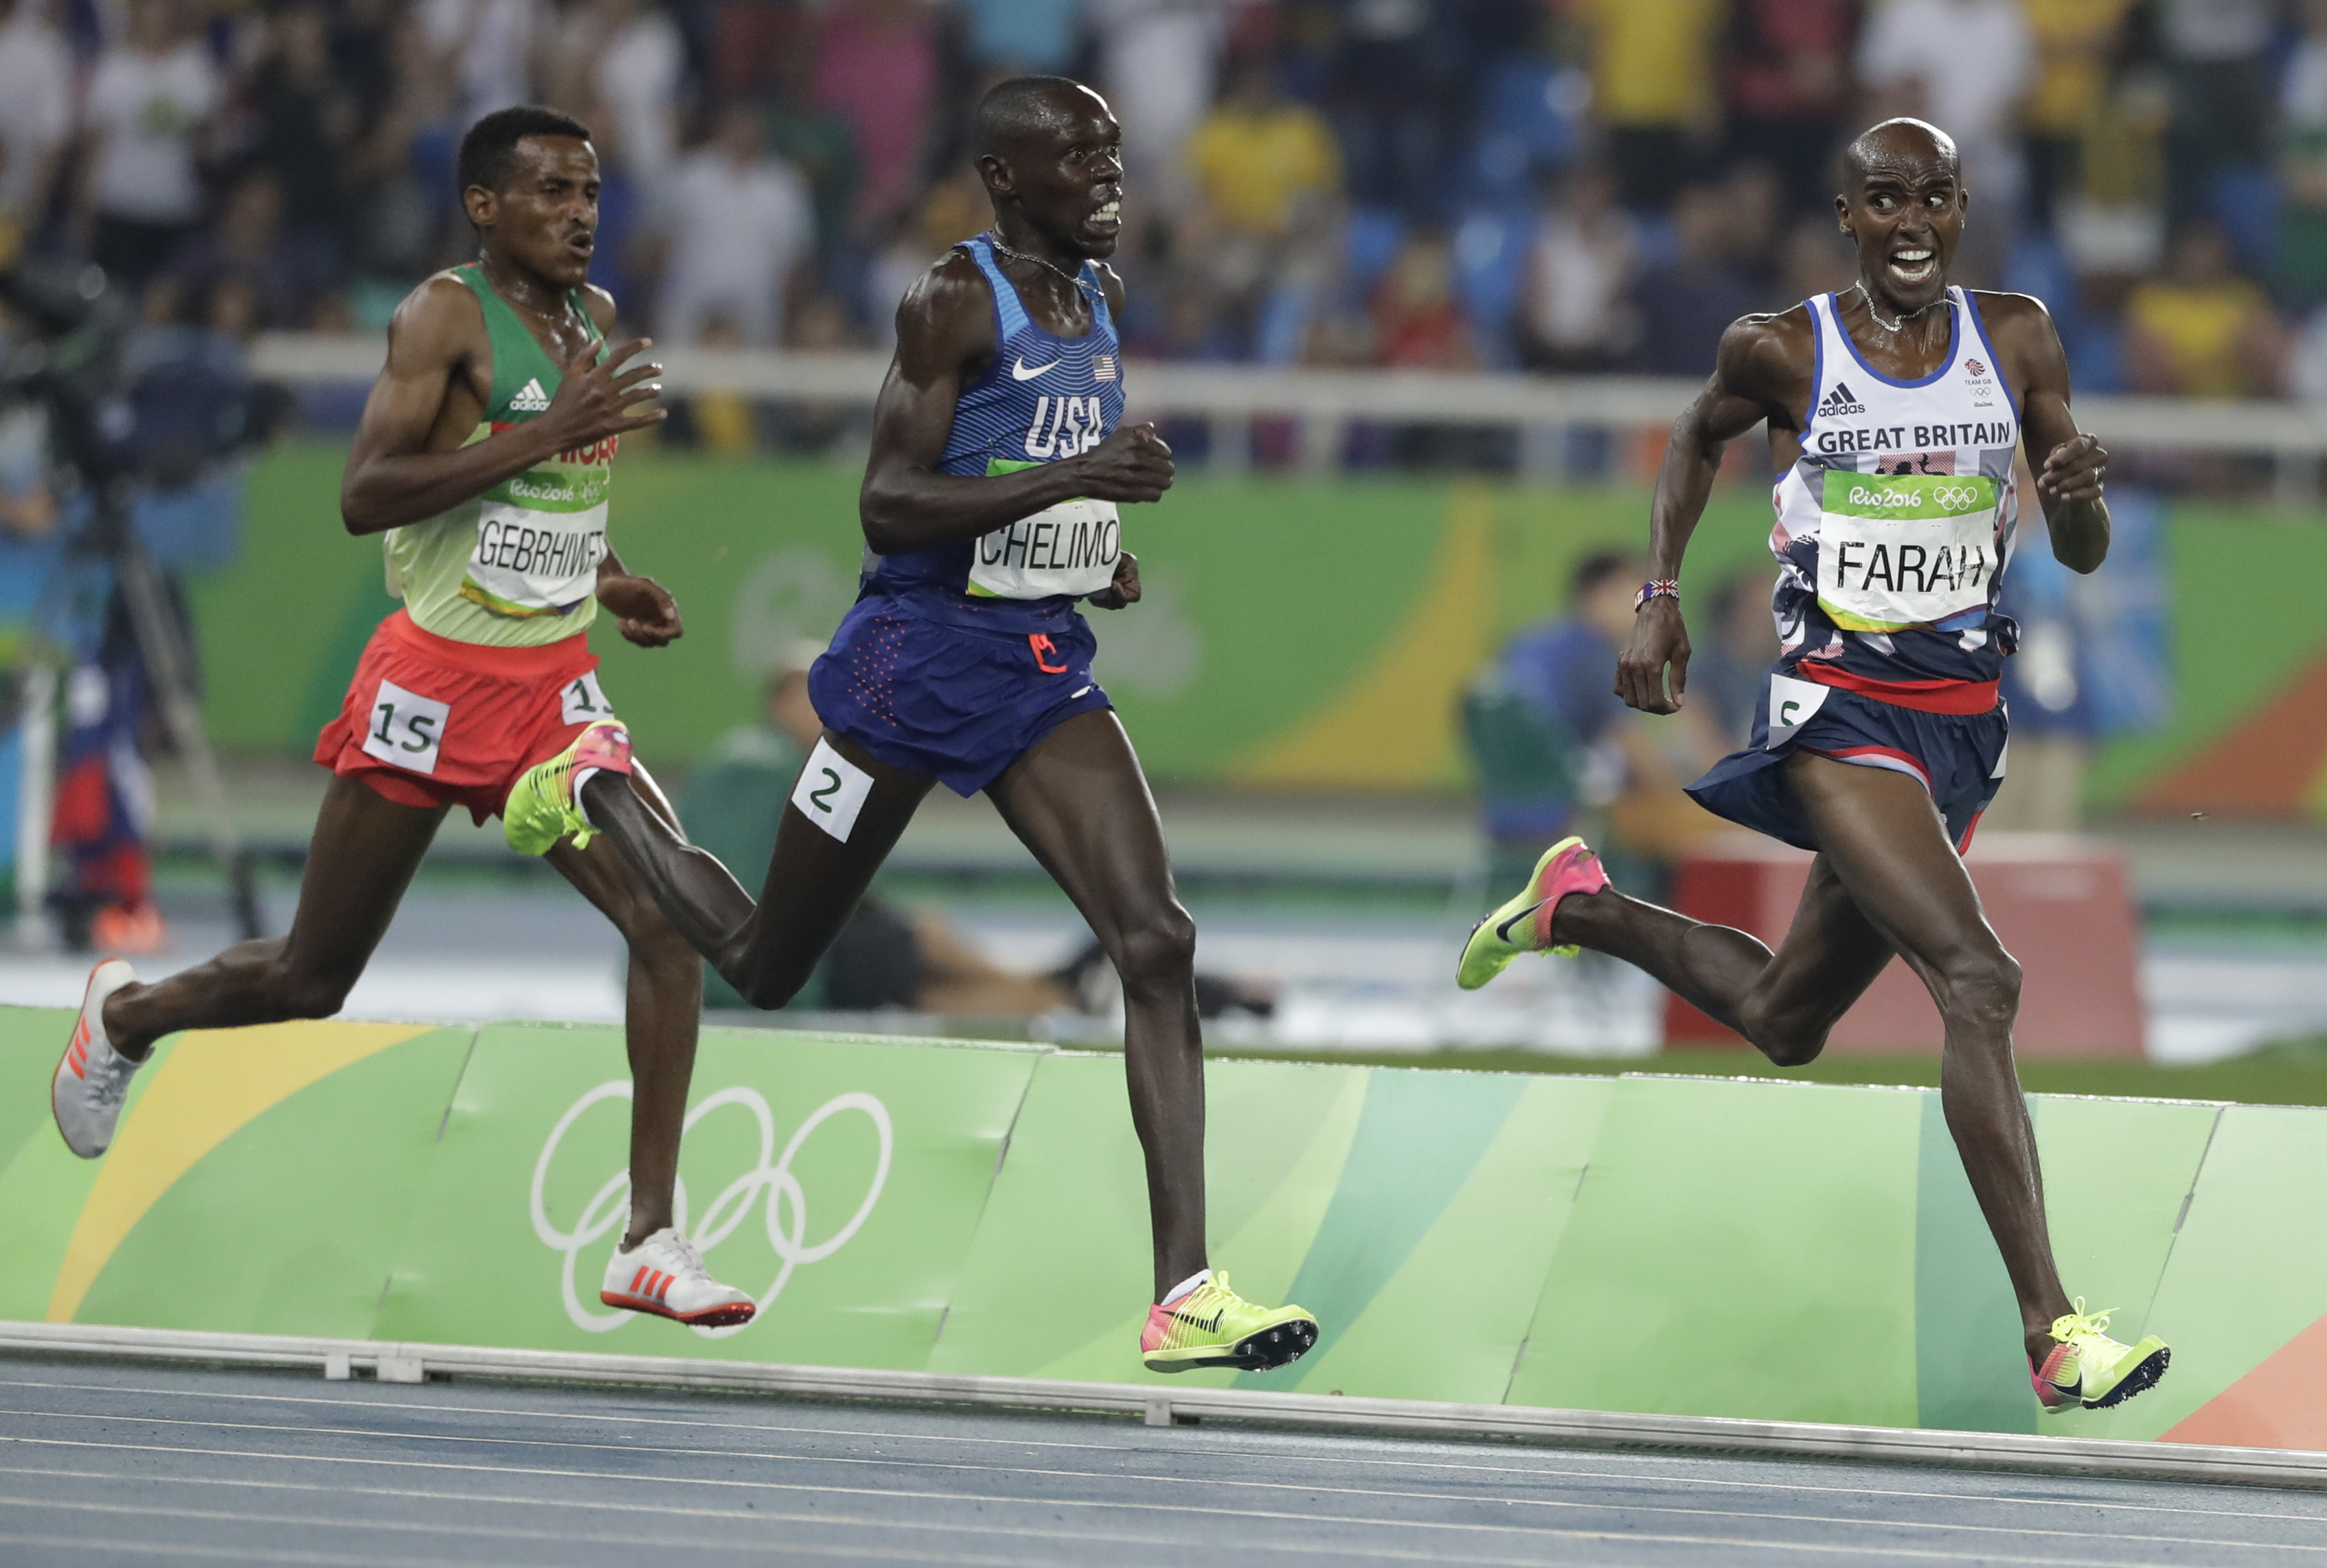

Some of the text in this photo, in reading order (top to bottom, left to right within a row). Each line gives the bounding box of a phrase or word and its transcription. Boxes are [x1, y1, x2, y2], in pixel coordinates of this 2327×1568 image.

[1024, 396, 1102, 459] USA
[1817, 402, 1865, 418] adidas
[1817, 421, 2010, 453] GREAT BRITAIN
[1849, 486, 1922, 508] Rio2016
[981, 519, 1119, 569] CHELIMO
[1837, 541, 1985, 593] FARAH
[373, 703, 435, 753] 15
[810, 767, 841, 814] 2
